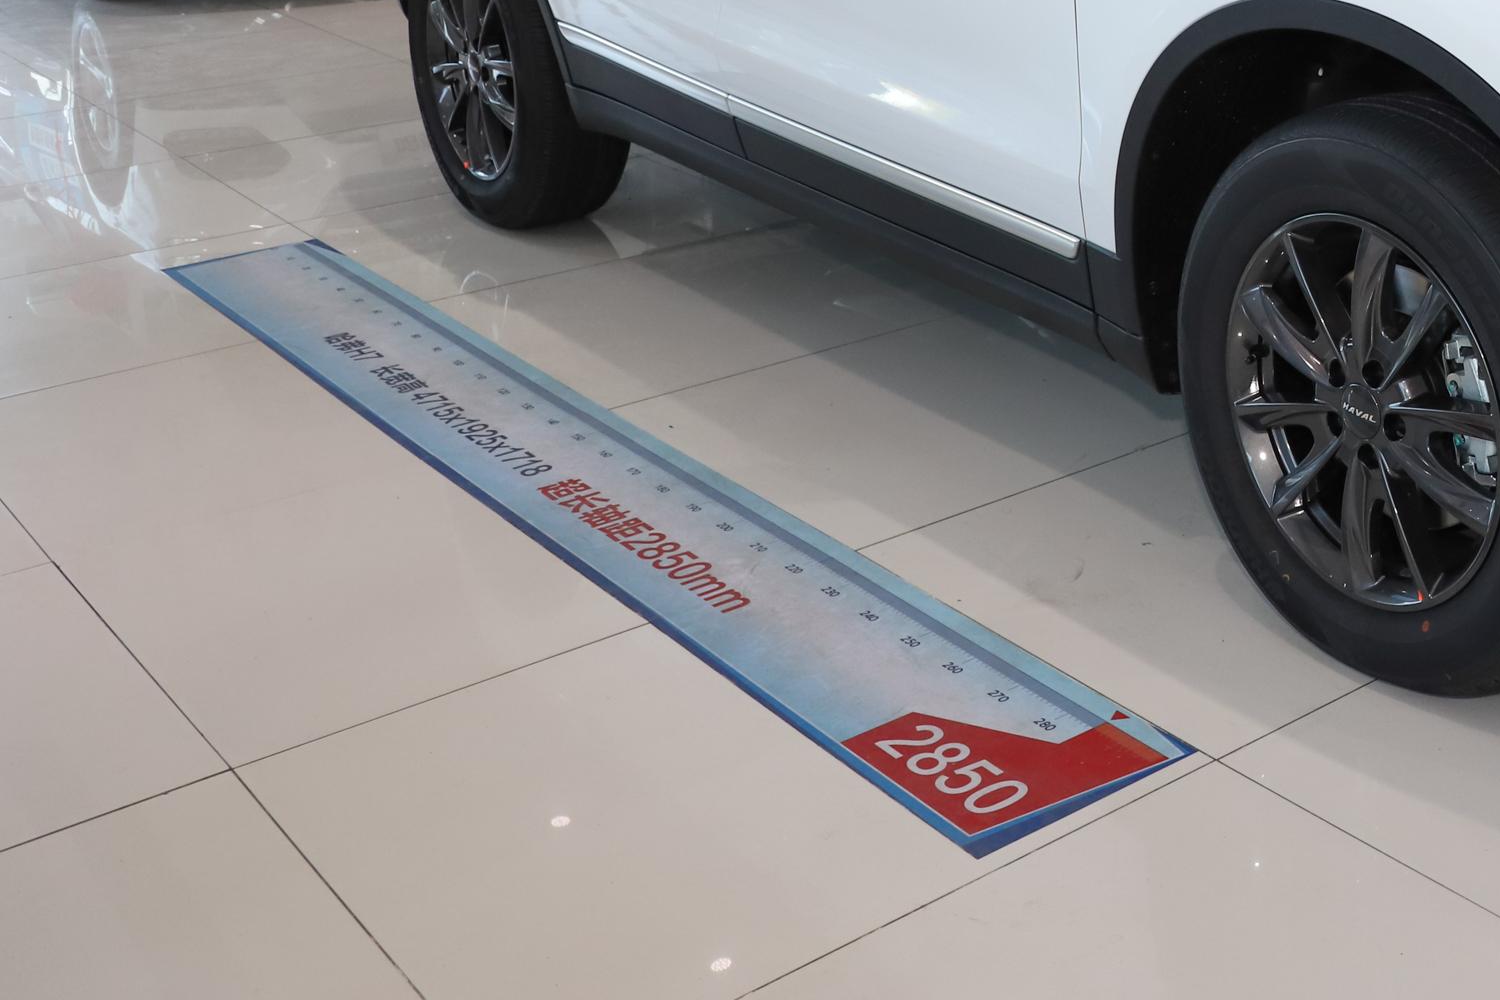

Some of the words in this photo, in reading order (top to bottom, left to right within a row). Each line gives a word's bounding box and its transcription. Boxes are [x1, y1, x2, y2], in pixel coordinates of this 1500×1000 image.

[324, 332, 385, 361] 哈弗H7
[369, 364, 429, 394] 长宽高
[411, 391, 553, 477] 4715x1925x1718
[537, 478, 752, 614] 超长轴距2850mm
[1342, 401, 1377, 423] HAVAL
[716, 522, 734, 532] 200
[749, 542, 768, 552] 210
[784, 563, 804, 575] 220
[820, 586, 841, 598] 230
[859, 609, 880, 622] 240
[900, 635, 921, 649] 250
[942, 661, 964, 675] 260
[987, 689, 1010, 704] 270
[1033, 717, 1057, 732] 280
[874, 724, 1029, 814] 2850
